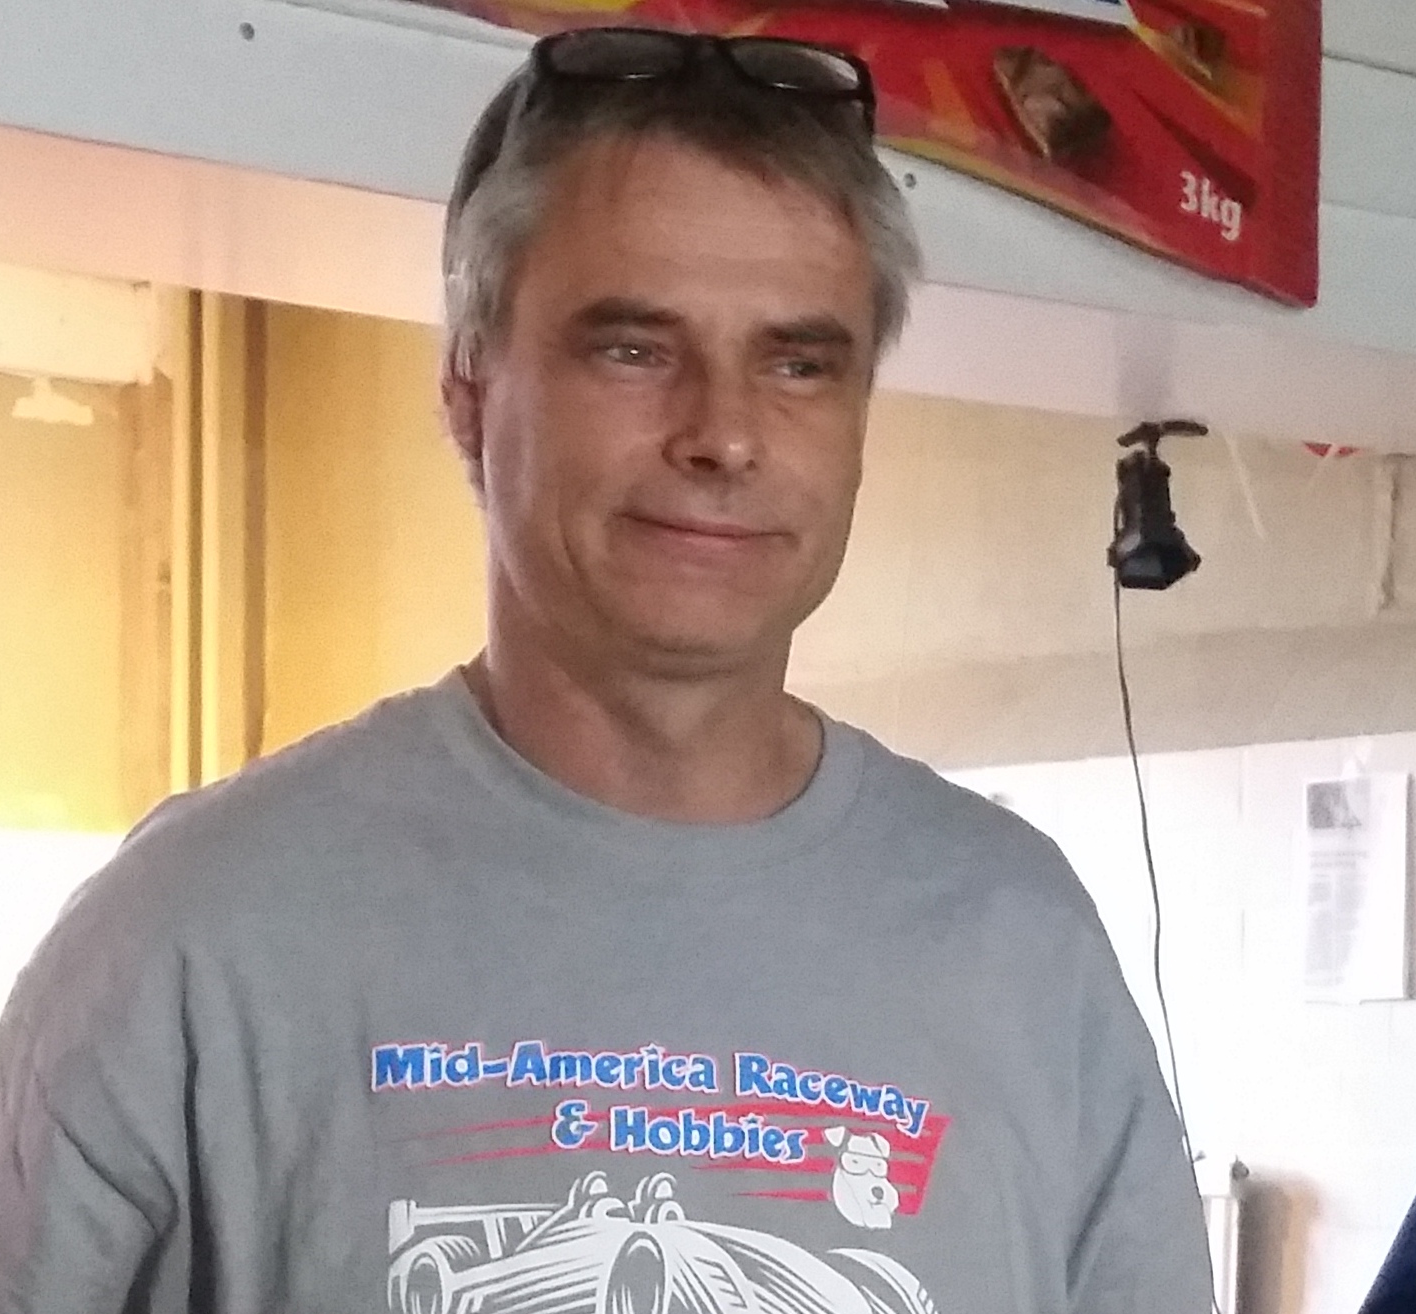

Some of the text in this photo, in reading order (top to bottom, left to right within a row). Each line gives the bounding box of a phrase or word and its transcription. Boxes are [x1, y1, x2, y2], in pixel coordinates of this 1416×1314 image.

[1179, 170, 1243, 241] 3kg
[371, 1038, 930, 1139] Mid-America Raceway
[551, 1099, 808, 1164] & Hobbies
